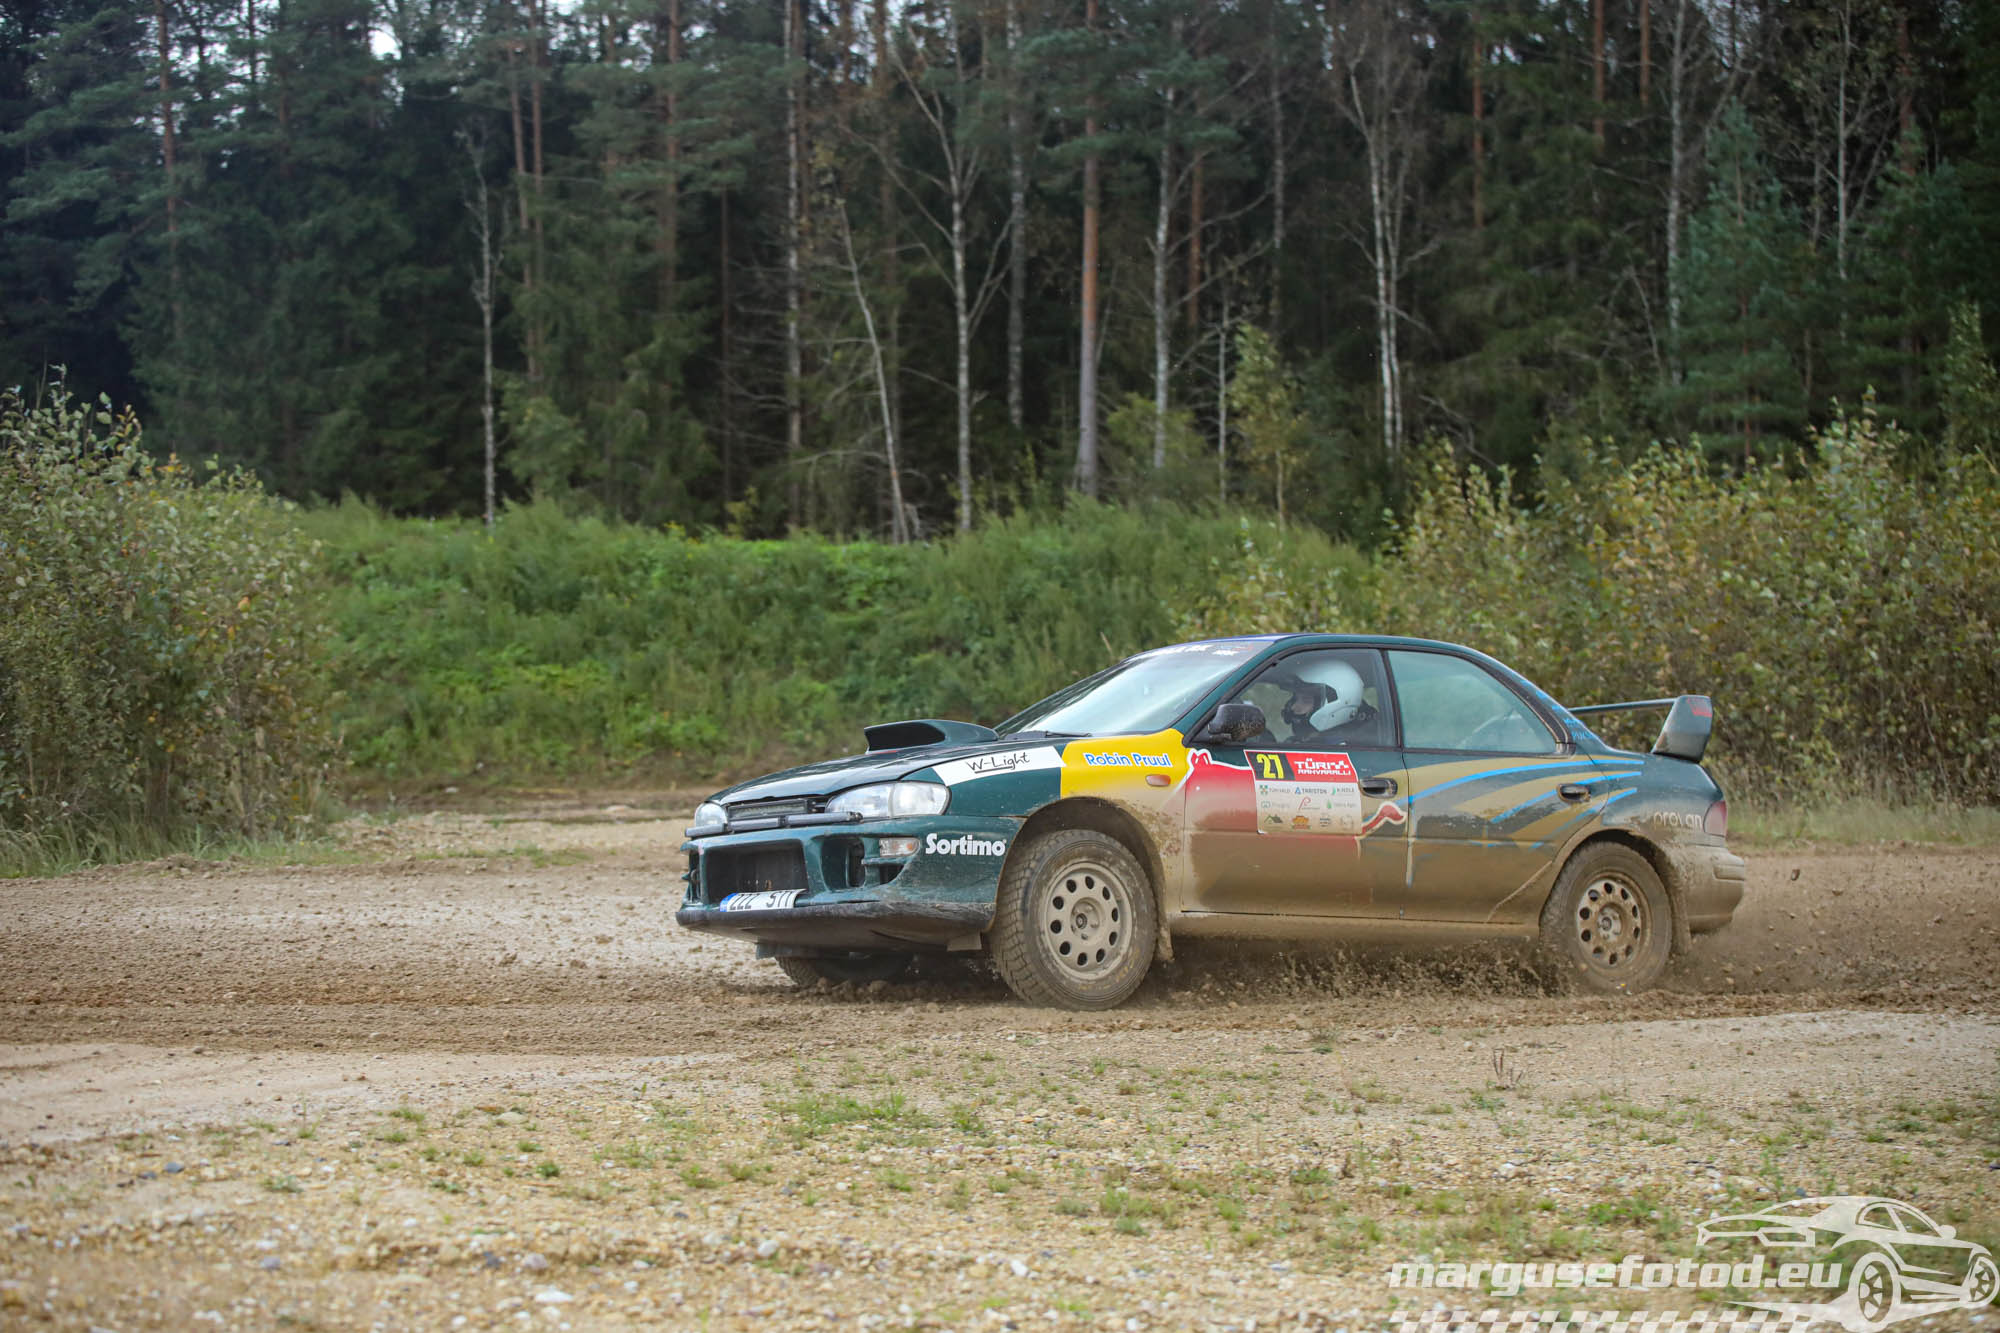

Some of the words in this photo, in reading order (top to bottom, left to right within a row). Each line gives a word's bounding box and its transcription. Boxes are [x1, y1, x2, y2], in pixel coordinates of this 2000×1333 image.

[965, 752, 1030, 771] W-Light
[1083, 752, 1132, 766] Robin
[1133, 753, 1174, 767] Pruul
[1256, 753, 1285, 779] 27
[925, 832, 1006, 857] Sortimo
